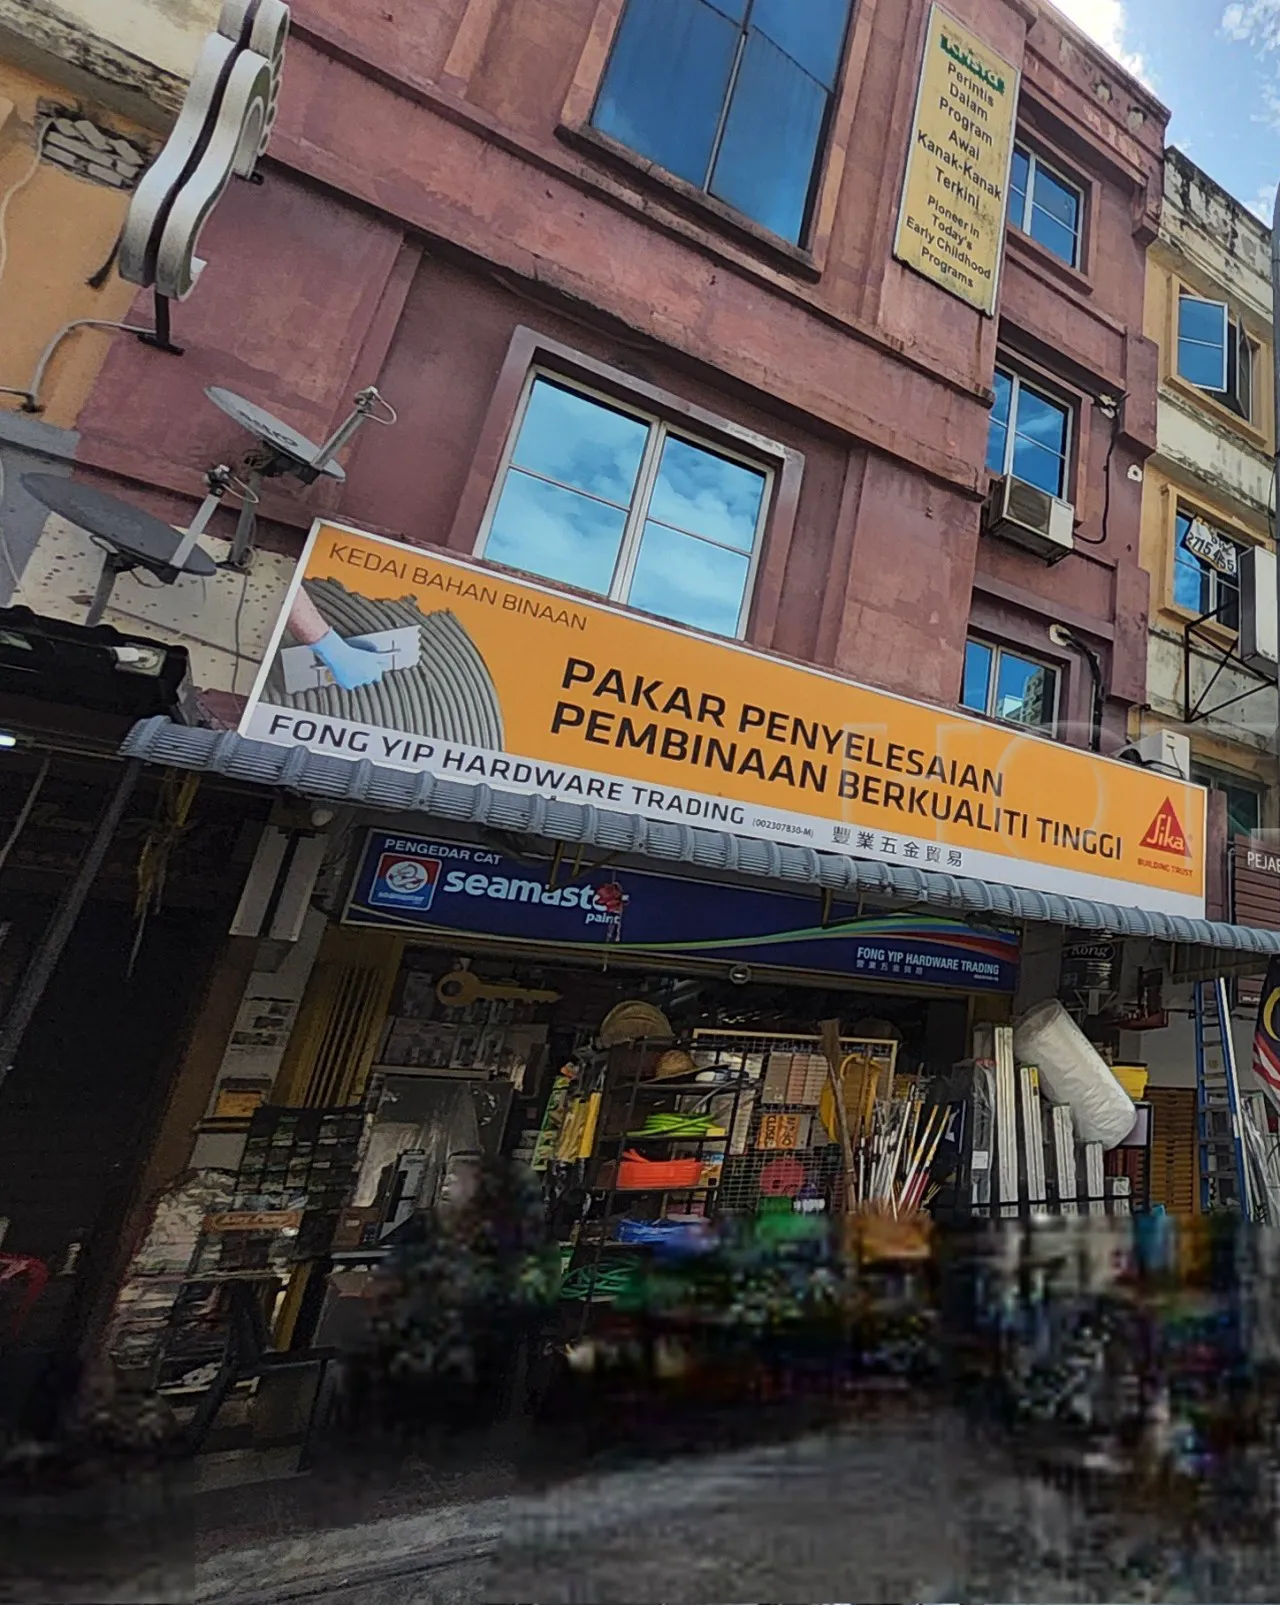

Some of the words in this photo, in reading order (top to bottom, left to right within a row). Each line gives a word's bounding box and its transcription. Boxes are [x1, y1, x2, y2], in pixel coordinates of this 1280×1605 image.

[947, 61, 994, 107] Perintis
[949, 82, 988, 122] Dalam
[939, 96, 993, 147] Program
[917, 130, 1002, 201] Kanak-Kanak
[948, 130, 980, 160] Awal
[935, 167, 979, 210] Terkini
[927, 195, 969, 231] Pioneer
[932, 214, 973, 251] Today's
[906, 216, 936, 243] Early
[936, 237, 992, 280] Childhood
[921, 247, 974, 288] Programs
[329, 542, 407, 579] KEDAI
[411, 566, 499, 605] BAHAN
[502, 593, 588, 631] BINAAN
[561, 657, 727, 729] PAKAR
[737, 703, 1004, 798] PENYELESAIAN
[268, 714, 371, 753] FONG
[381, 735, 435, 764] YIP
[441, 749, 624, 802] HARDWARE
[631, 786, 746, 825] TRADING
[550, 700, 828, 794] PEMBINAAN
[838, 768, 1029, 839] BERKUALITI
[1036, 816, 1122, 861] TINGGI
[384, 838, 471, 861] PENGEDAR
[472, 851, 503, 866] CAT
[1146, 813, 1185, 851] Sika
[1137, 857, 1170, 875] BUILDING
[1171, 865, 1194, 877] TRUST
[856, 946, 885, 961] FONG
[887, 950, 905, 962] YIP
[905, 953, 960, 971] HARDWARE
[960, 960, 1000, 976] TRADING
